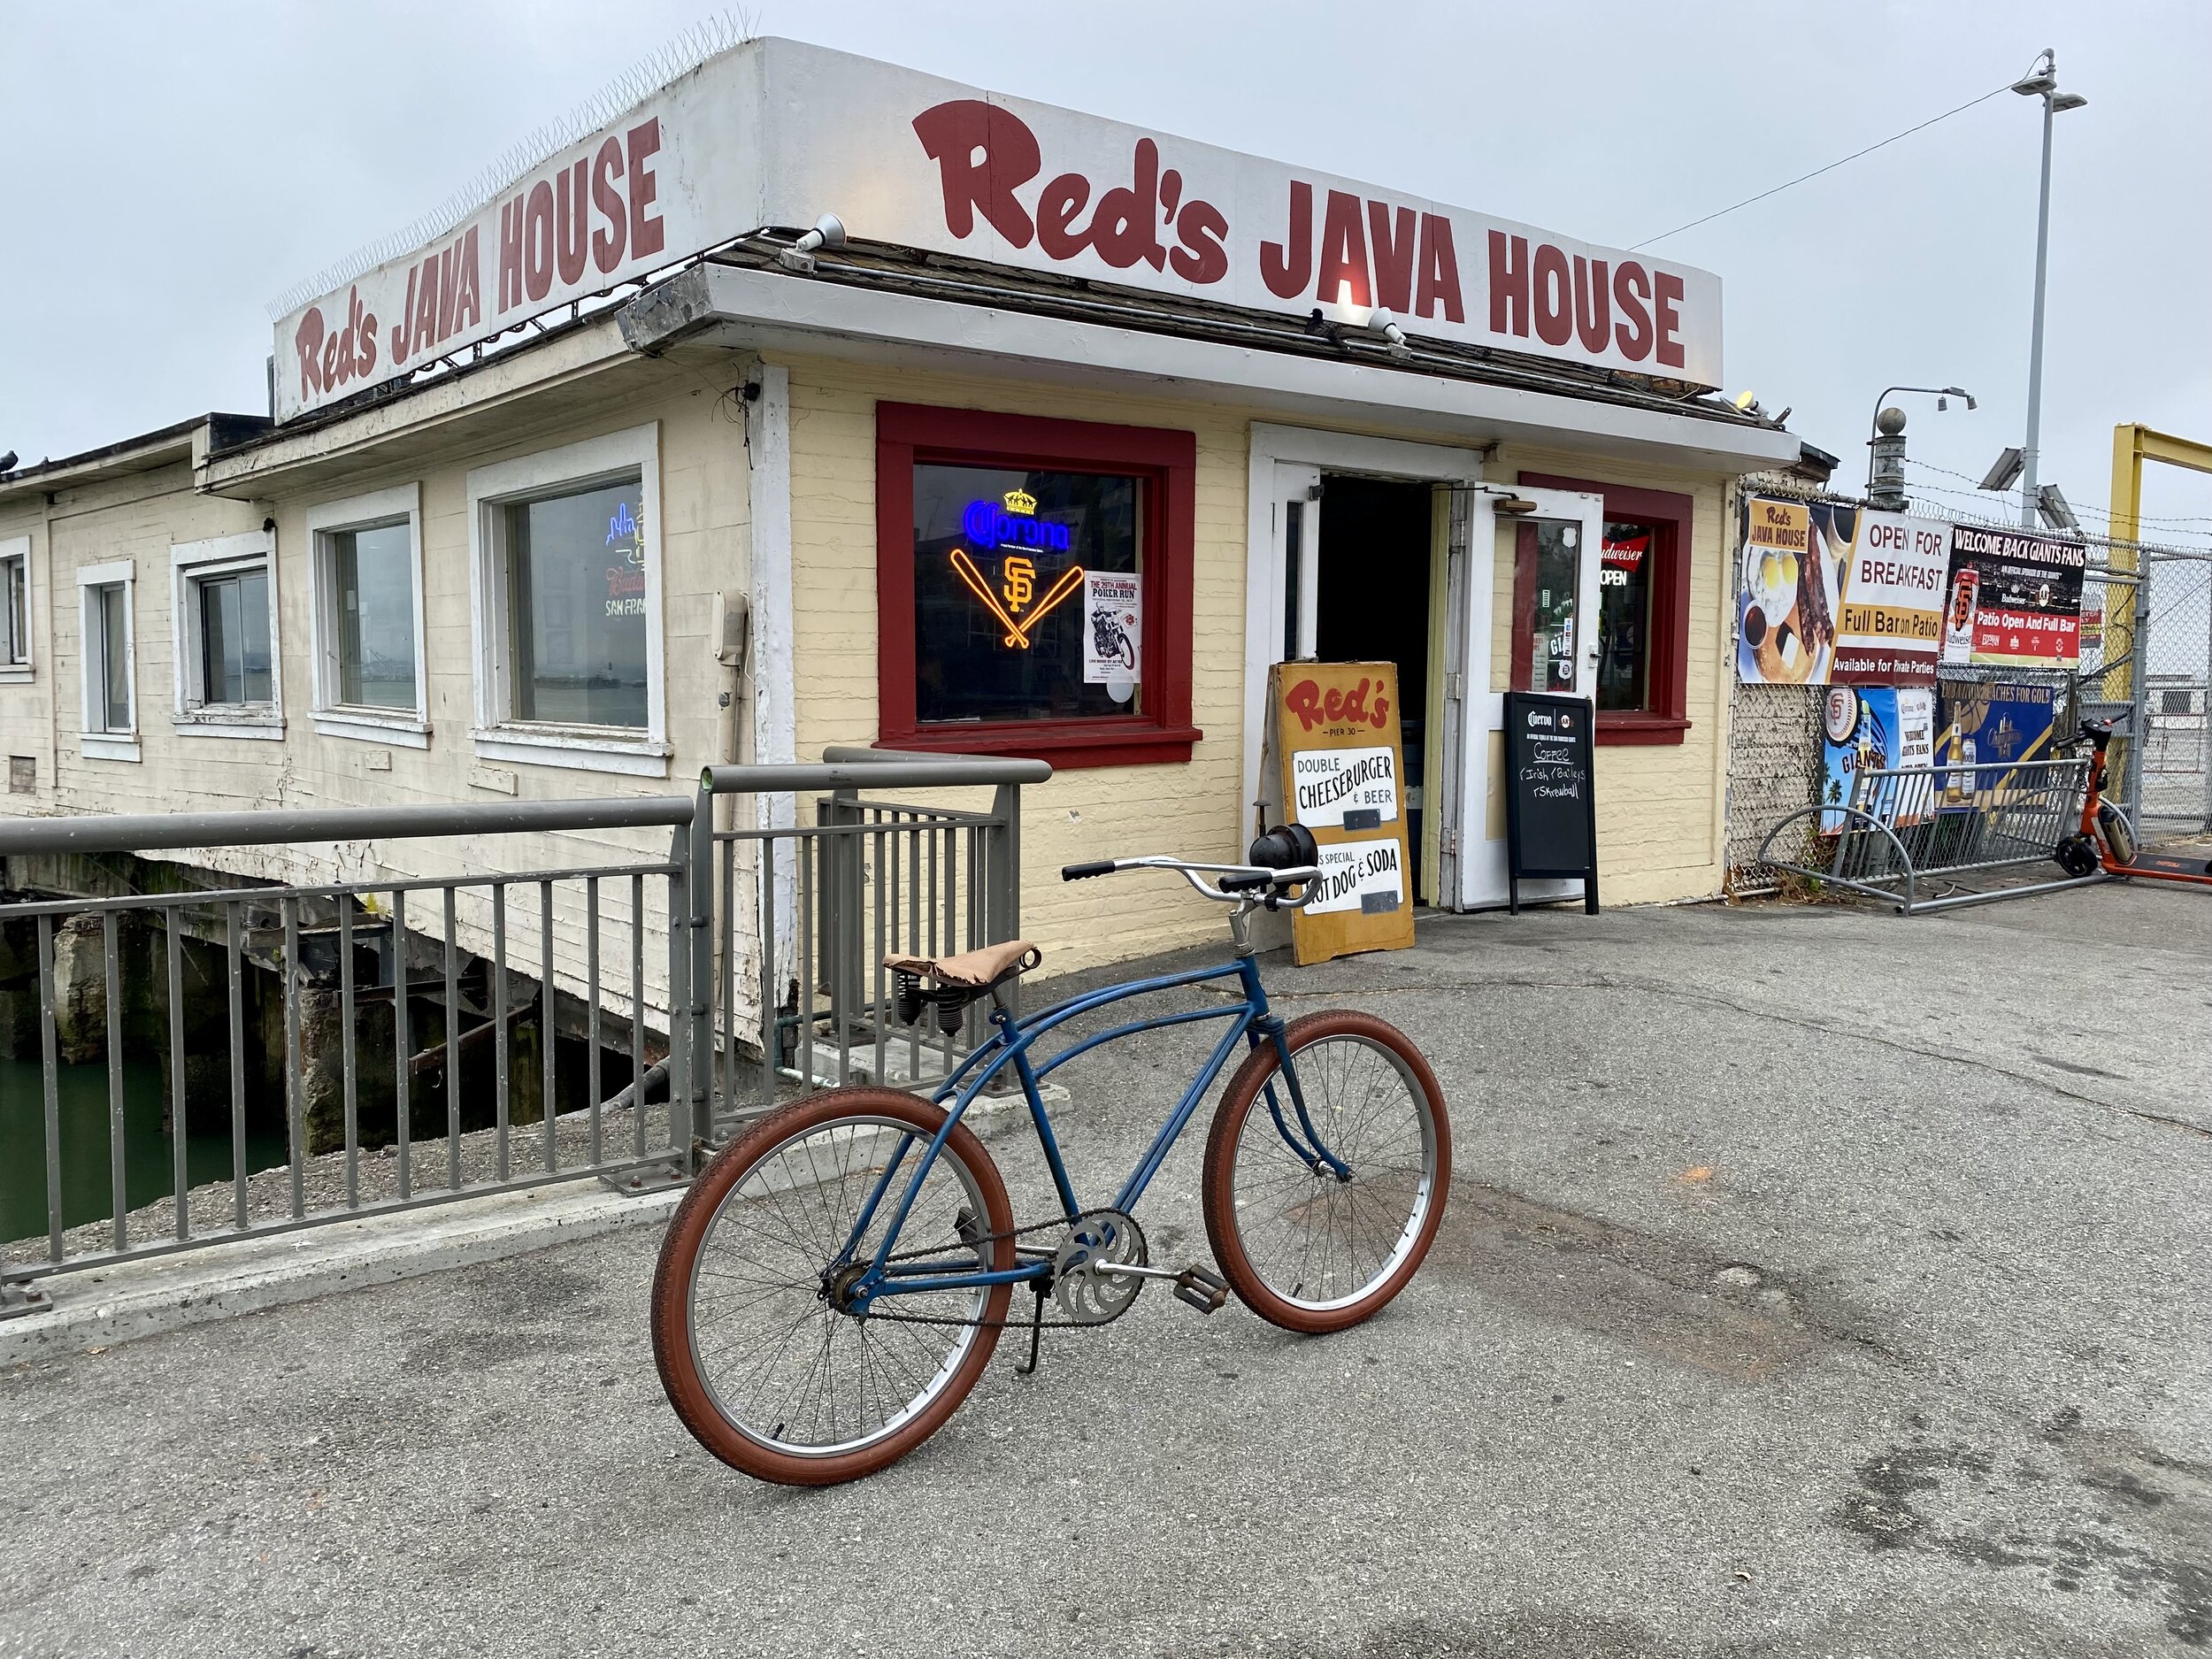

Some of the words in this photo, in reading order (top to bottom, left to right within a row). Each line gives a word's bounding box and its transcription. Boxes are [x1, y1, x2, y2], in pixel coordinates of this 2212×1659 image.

[912, 99, 1229, 284] Red's
[1259, 180, 1464, 325] JAVA
[1487, 228, 1686, 369] HOUSE
[296, 283, 378, 403] Red's
[391, 223, 480, 366] JAVA
[498, 116, 665, 316] HOUSE
[964, 499, 1070, 550] Corona
[1766, 505, 1792, 526] Red's
[1752, 524, 1773, 544] JAVA
[1775, 527, 1806, 548] HOUSE
[1870, 524, 1909, 550] OPEN
[1916, 531, 1942, 557] FOR
[1955, 528, 2003, 556] WELCOME
[2002, 536, 2031, 560] BACK
[2030, 541, 2063, 565] GIANTS
[2062, 546, 2085, 567] FANS
[1090, 580, 1101, 588] THE
[1115, 582, 1137, 591] ANNUAL
[1600, 569, 1627, 586] OPEN
[1861, 560, 1943, 591] BREAKFAST
[1092, 588, 1118, 598] POKER
[1119, 589, 1135, 599] RUN
[605, 599, 624, 617] SAN
[1845, 609, 1871, 632] Full
[1875, 611, 1898, 634] Bar
[1901, 619, 1910, 634] on
[1912, 614, 1938, 637] Patio
[1977, 611, 2000, 626] Patio
[2001, 613, 2024, 631] Open
[2025, 616, 2043, 628] And
[2043, 617, 2059, 632] Full
[2060, 620, 2077, 634] Bar
[1832, 657, 1876, 673] Available
[1878, 658, 1893, 673] for
[1893, 660, 1910, 673] Private
[1911, 661, 1935, 675] Parties
[1285, 677, 1390, 733] Red's
[2016, 687, 2031, 703] FOR
[2032, 687, 2051, 704] GOLD
[1527, 710, 1552, 727] Cuervo
[1329, 727, 1346, 738] PIER
[1347, 726, 1356, 736] 30
[1297, 757, 1340, 774] DOUBLE
[1298, 756, 1393, 810] CHEESEBURGER
[1364, 788, 1393, 805] BEER
[1325, 851, 1356, 865] SPECIAL
[1332, 864, 1356, 900] DOG
[1366, 848, 1398, 877] SODA
